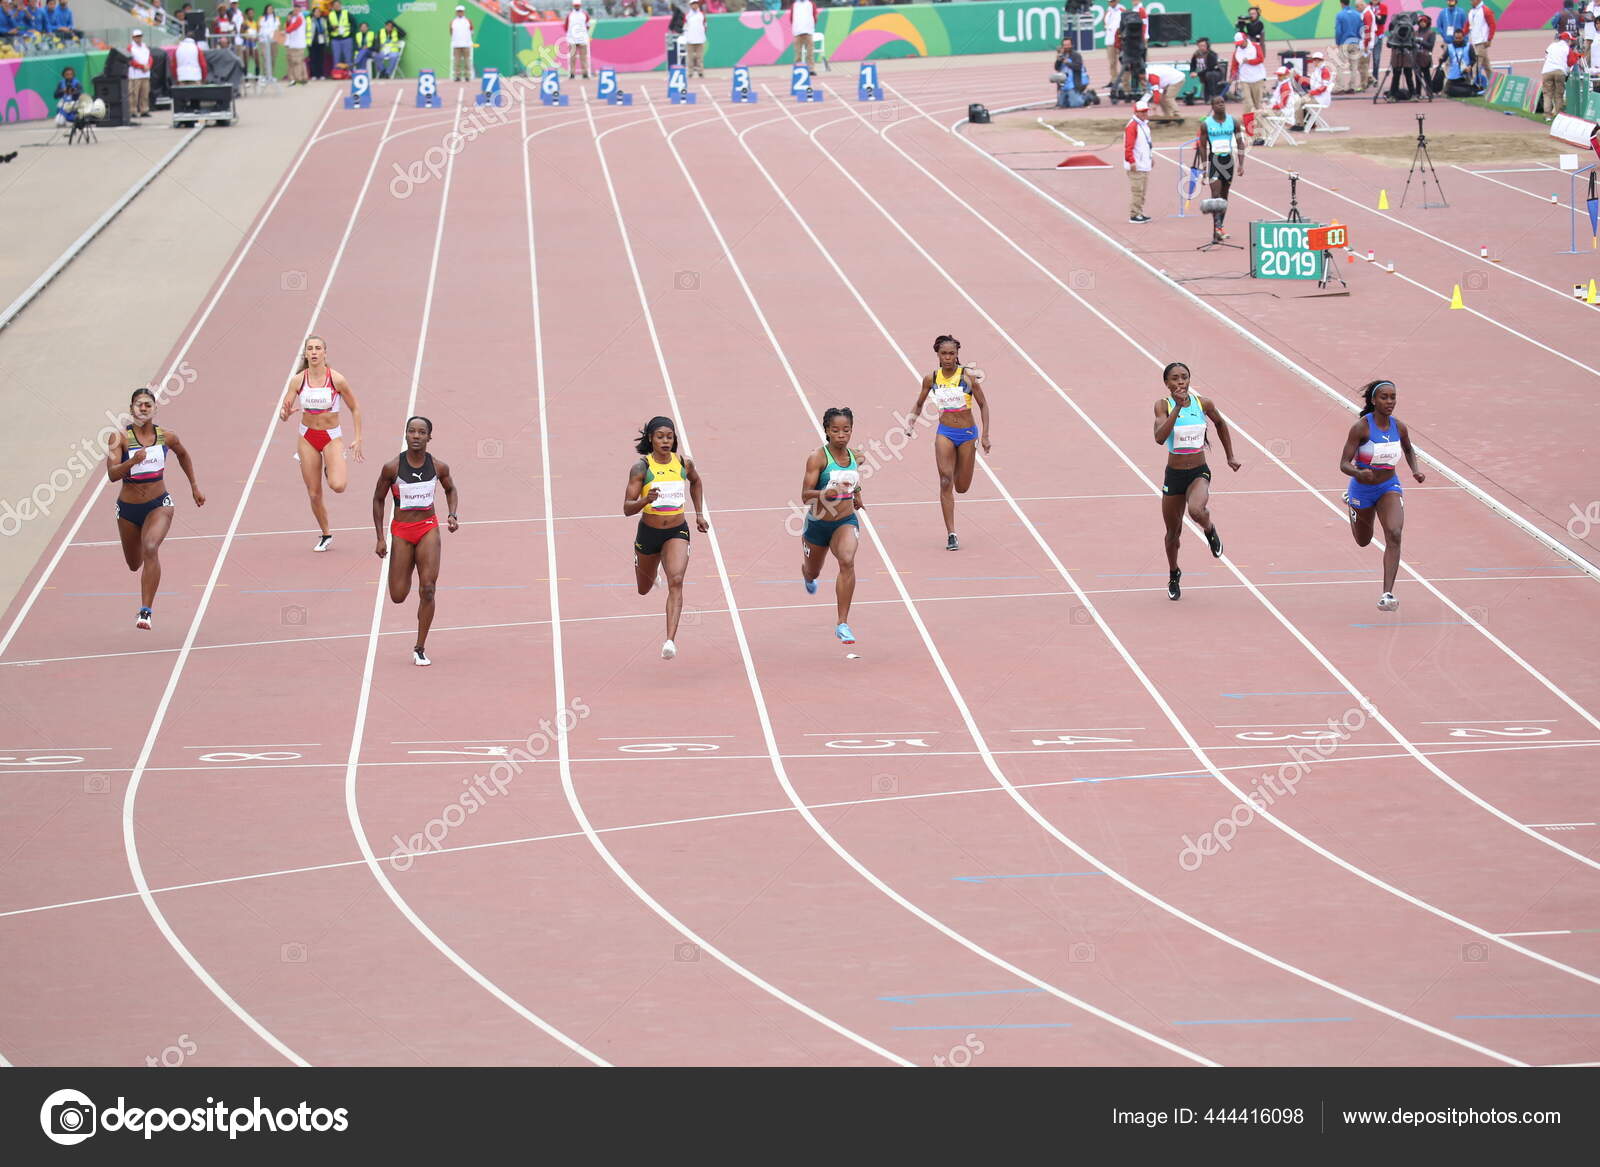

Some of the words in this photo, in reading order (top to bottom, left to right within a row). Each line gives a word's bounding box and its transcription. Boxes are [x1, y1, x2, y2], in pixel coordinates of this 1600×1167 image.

[998, 6, 1064, 42] LIM
[353, 74, 369, 96] 9
[419, 74, 436, 96] 8
[483, 73, 498, 94] 7
[542, 72, 558, 95] 6
[600, 71, 615, 94] 5
[669, 69, 685, 91] 4
[734, 68, 750, 91] 3
[793, 68, 809, 90] 2
[861, 67, 875, 90] 1
[1261, 250, 1316, 276] 2019
